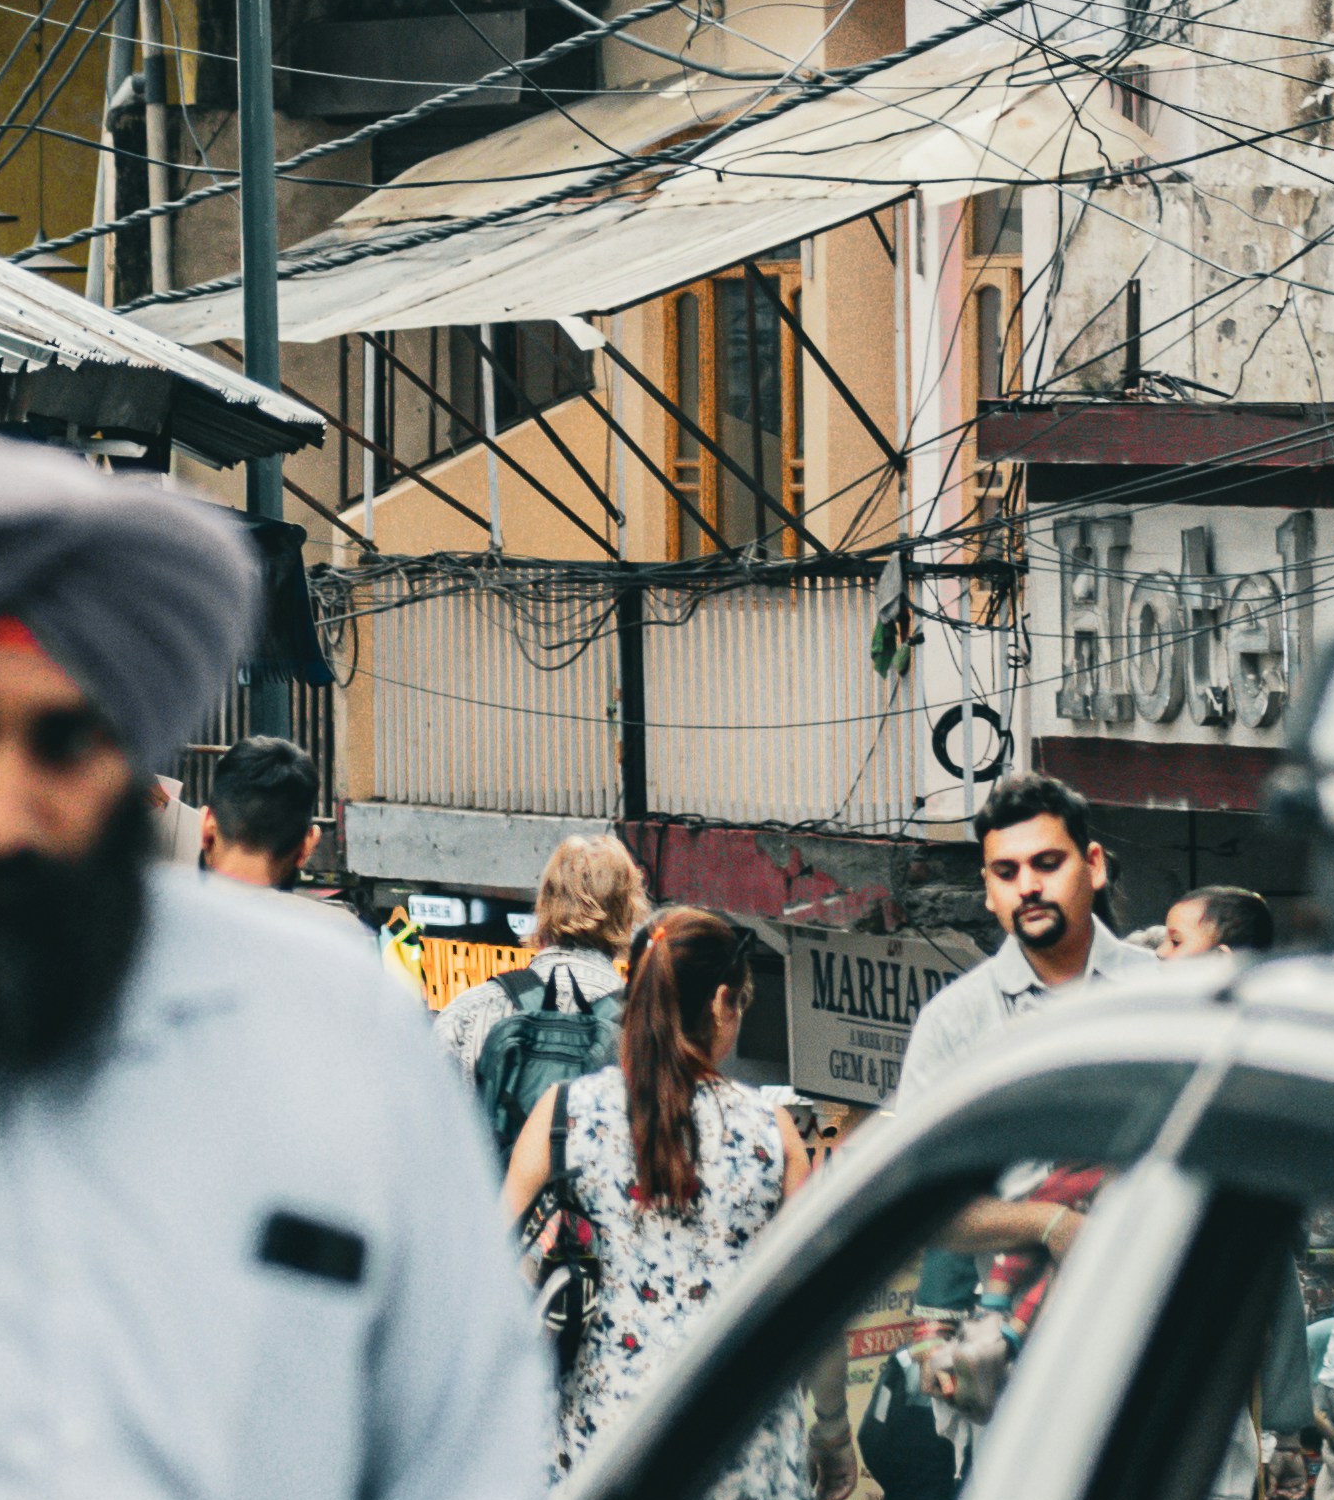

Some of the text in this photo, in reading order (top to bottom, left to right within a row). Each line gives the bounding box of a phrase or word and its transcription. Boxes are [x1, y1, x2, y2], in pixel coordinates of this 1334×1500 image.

[1053, 508, 1314, 729] Hotel
[810, 949, 958, 1025] MARHA
[829, 1050, 864, 1084] GEM
